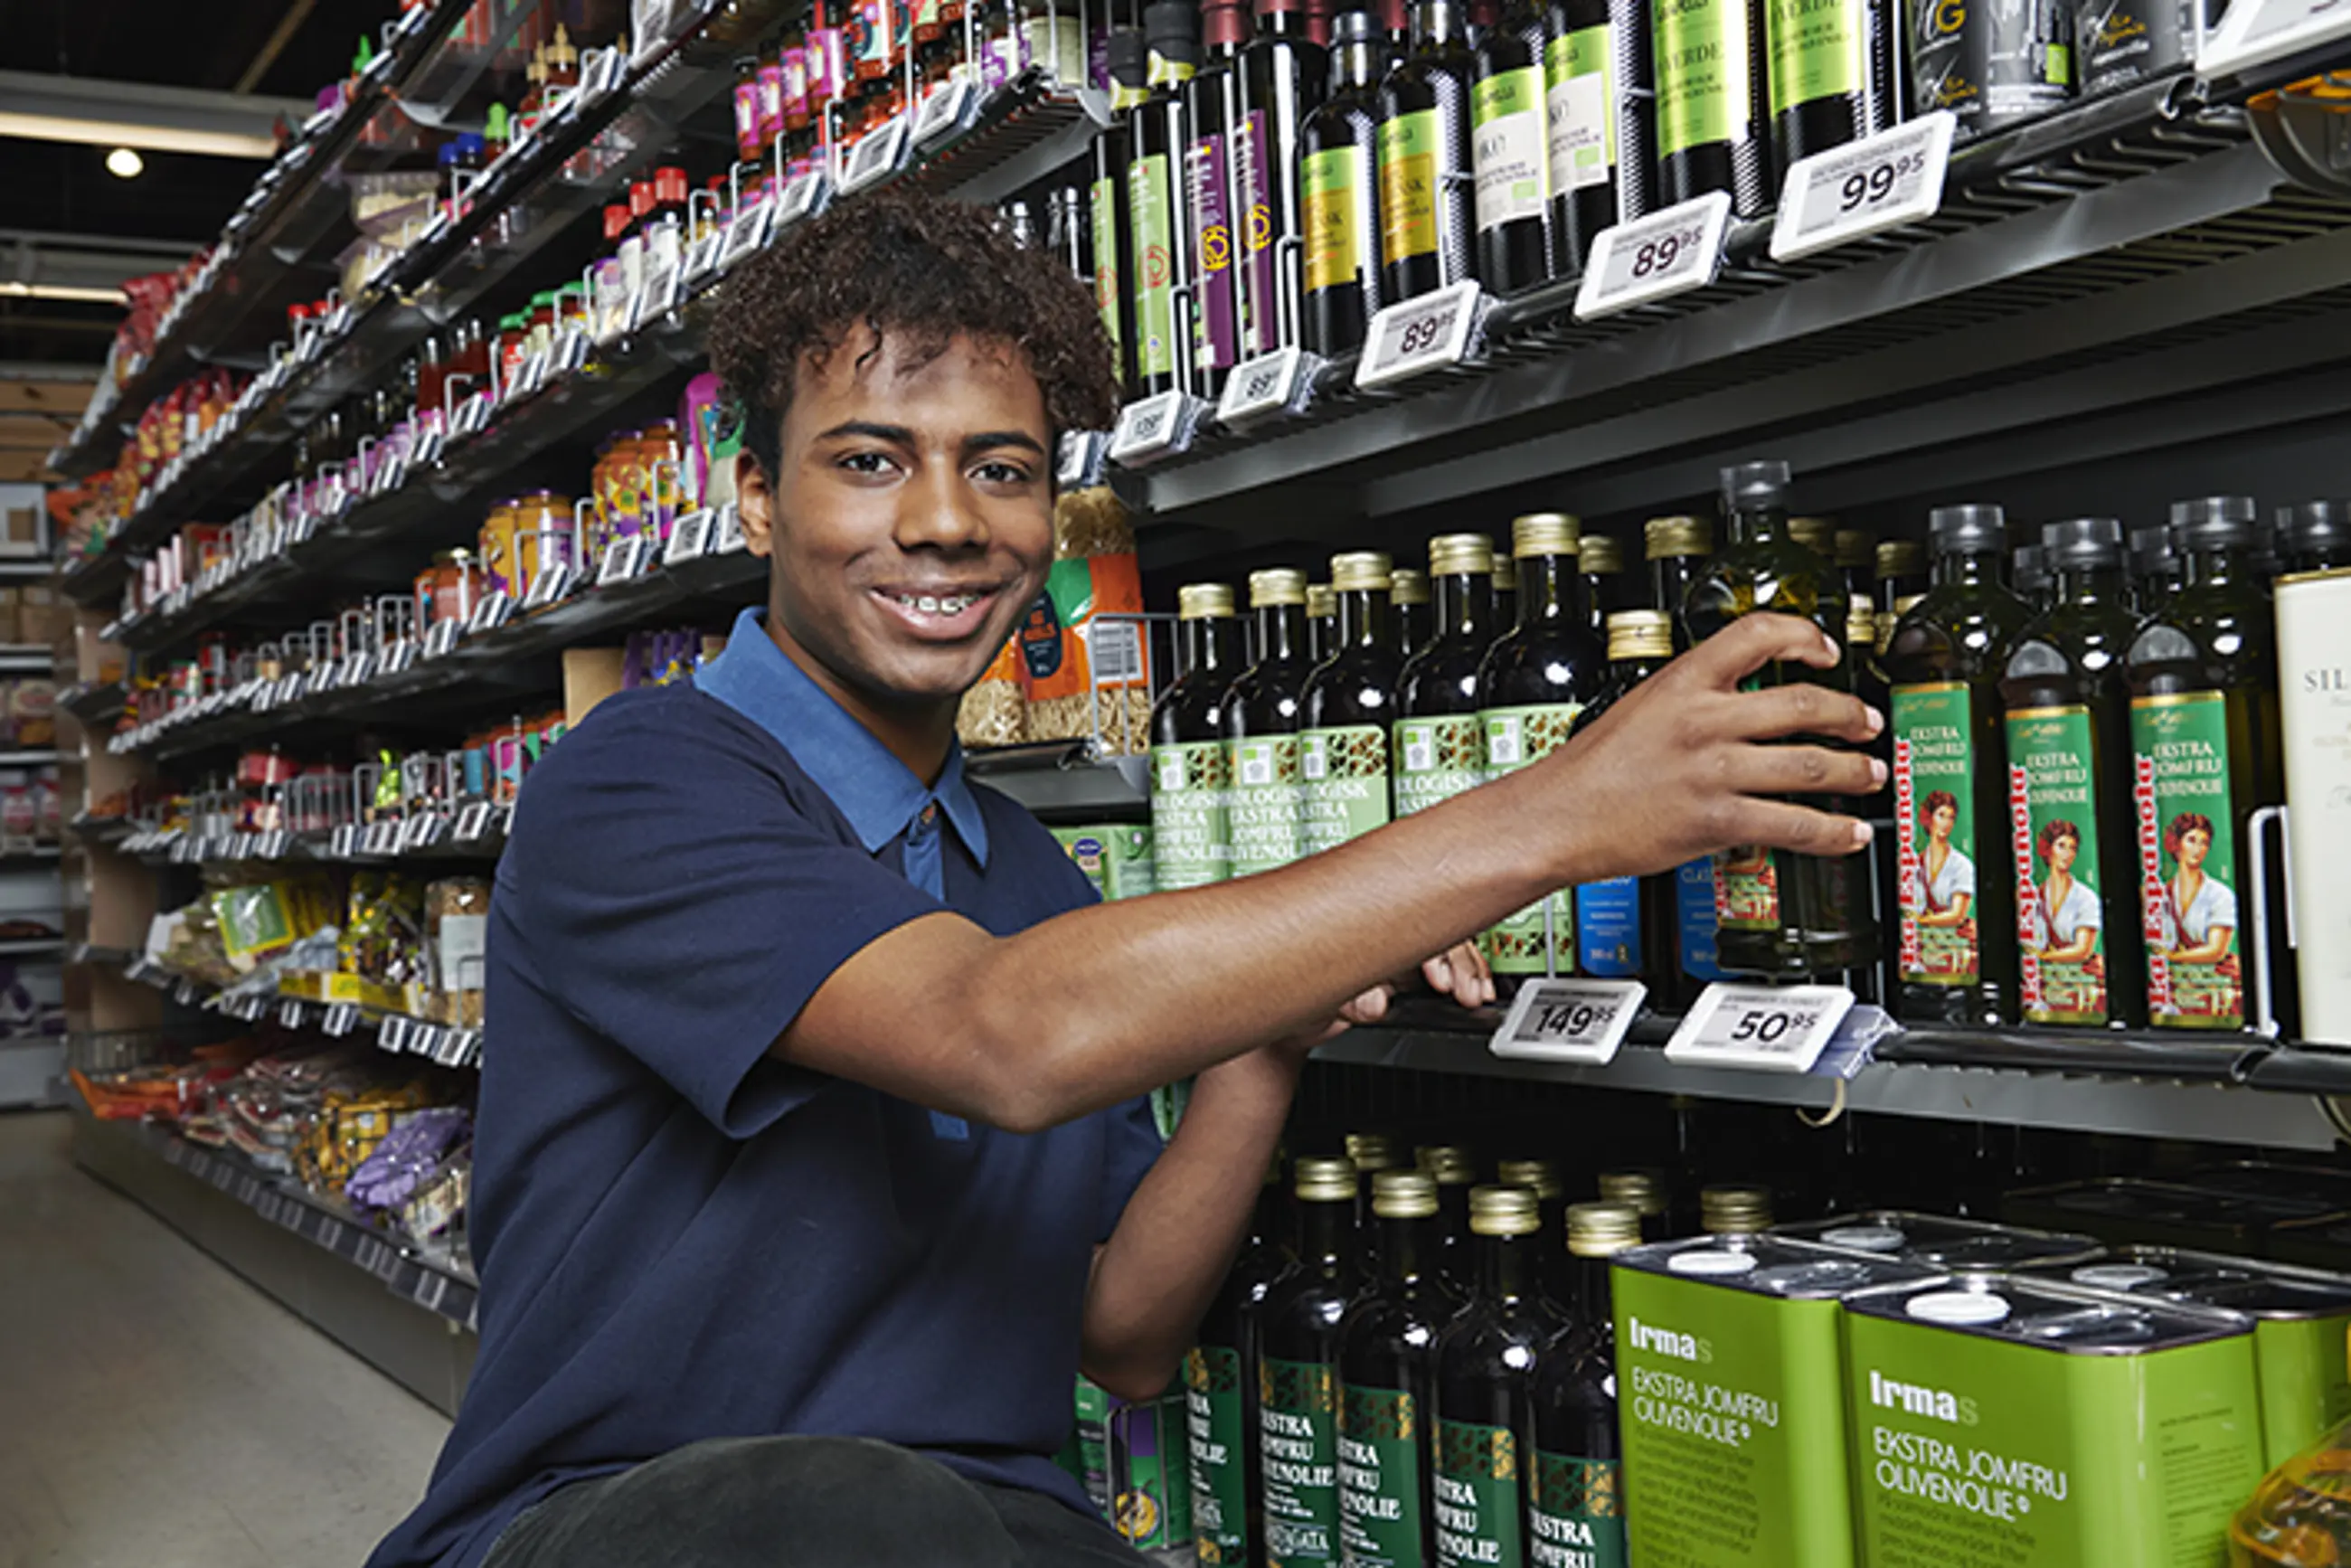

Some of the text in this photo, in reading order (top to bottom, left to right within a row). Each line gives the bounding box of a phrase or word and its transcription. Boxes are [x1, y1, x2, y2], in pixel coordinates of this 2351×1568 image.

[2153, 741, 2214, 758] EKSTRA
[1631, 1365, 1780, 1429] EKSTRA JOMFRU
[1874, 1426, 2068, 1502] EKSTRA JOMFRU
